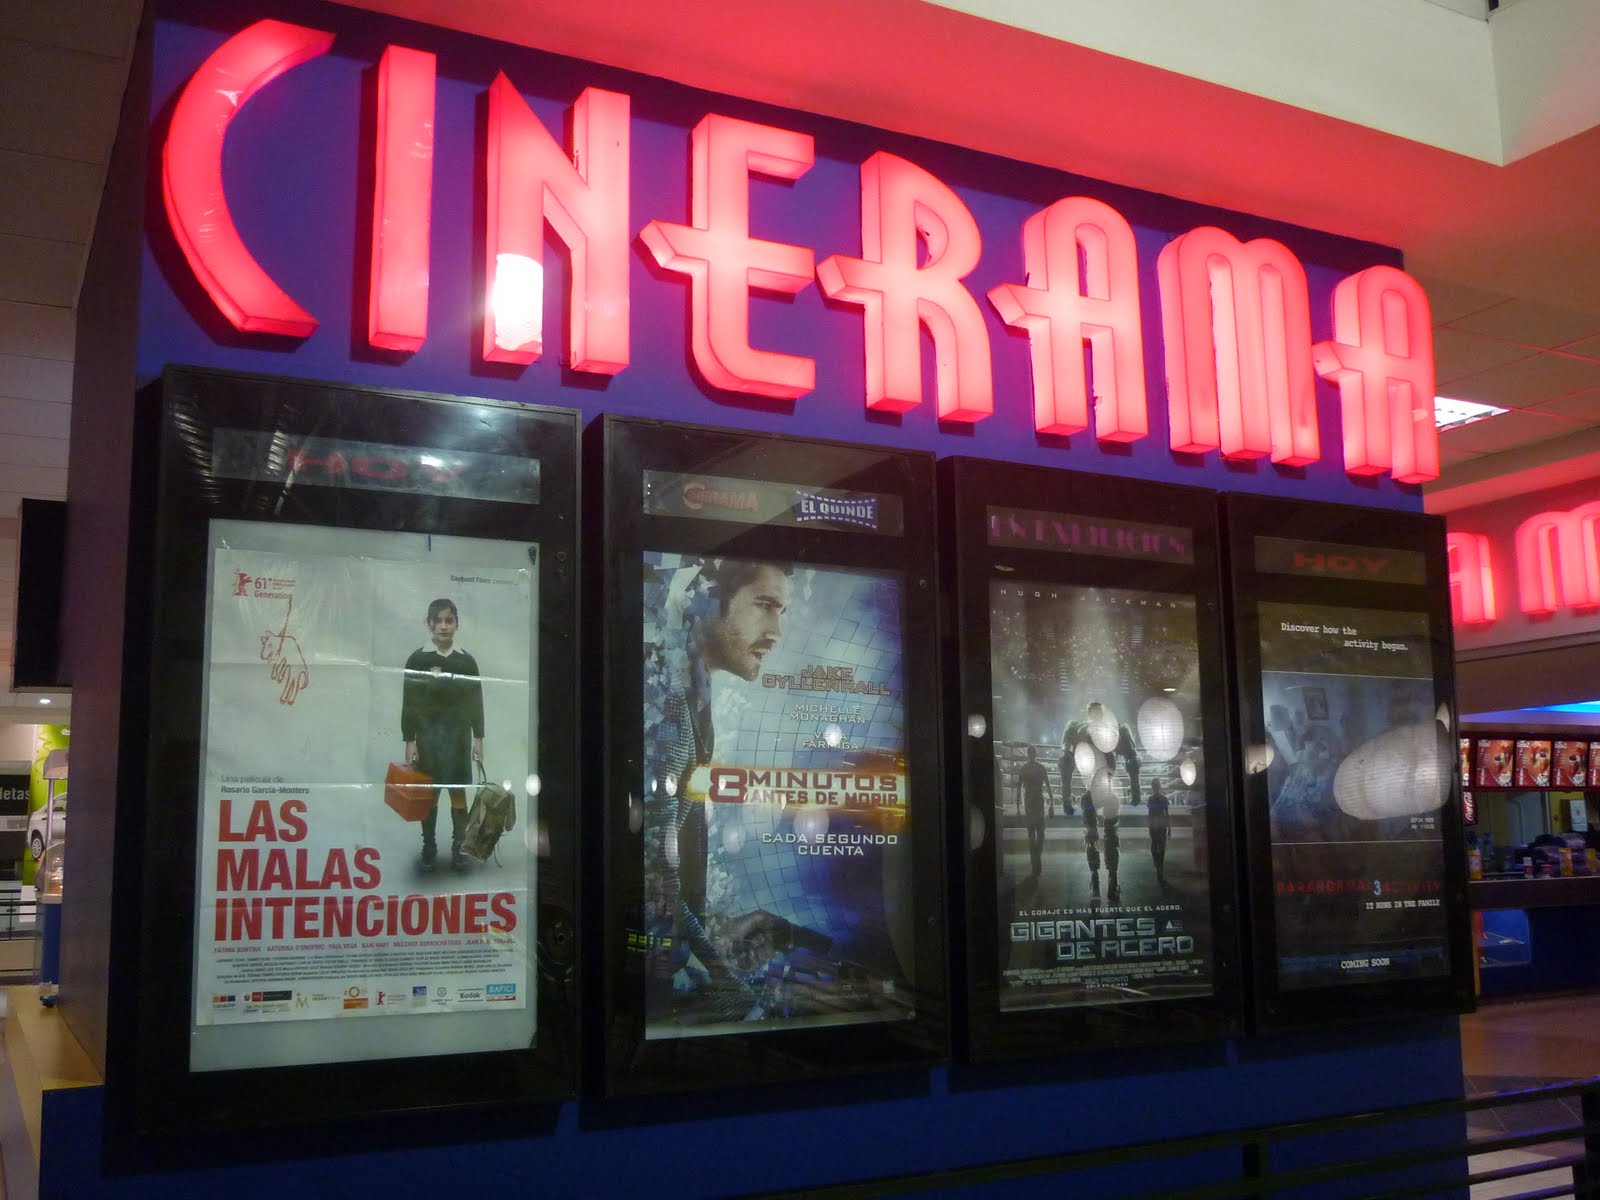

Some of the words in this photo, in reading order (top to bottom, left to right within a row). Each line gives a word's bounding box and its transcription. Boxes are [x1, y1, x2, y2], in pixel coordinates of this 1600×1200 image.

[162, 18, 1440, 485] CINERAMA
[800, 499, 816, 514] EL
[819, 502, 874, 519] QUINDE
[1294, 551, 1390, 573] HOY
[254, 590, 293, 601] Generation
[1000, 589, 1057, 599] HUGH
[1281, 622, 1320, 633] Discover
[1323, 625, 1339, 635] how
[1342, 626, 1357, 636] the
[1344, 639, 1379, 650] activity
[1381, 641, 1409, 652] began.
[801, 665, 854, 680] JAKE
[762, 673, 891, 695] GYLLENHALL
[795, 704, 862, 715] MICHELLE
[789, 713, 866, 724] MONAGHAN
[814, 731, 848, 740] VEA
[220, 775, 239, 783] Una
[273, 775, 285, 783] de
[708, 767, 748, 804] 8
[749, 770, 897, 791] MINUTOS
[221, 785, 250, 793] Rosario
[750, 789, 808, 805] ANTES
[815, 791, 839, 805] DE
[844, 792, 899, 806] MORIR
[218, 799, 309, 842] LAS
[762, 832, 808, 844] CADA
[815, 833, 898, 845] SEGUNDO
[798, 845, 864, 856] CUENTA
[215, 847, 382, 892] MALAS
[1373, 879, 1382, 896] 3
[1095, 905, 1124, 913] FUERTE
[1126, 905, 1141, 913] QUE
[1365, 902, 1374, 910] IT
[1394, 901, 1402, 909] IN
[1404, 900, 1416, 908] THE
[1418, 899, 1440, 908] FAMILY
[213, 891, 518, 942] INTENCIONES
[1010, 917, 1155, 942] GIGANTES
[1056, 941, 1096, 961] DE
[1101, 935, 1194, 958] ACERO
[1340, 959, 1369, 969] COMING
[1371, 957, 1390, 967] SOON
[459, 991, 481, 999] Kodak
